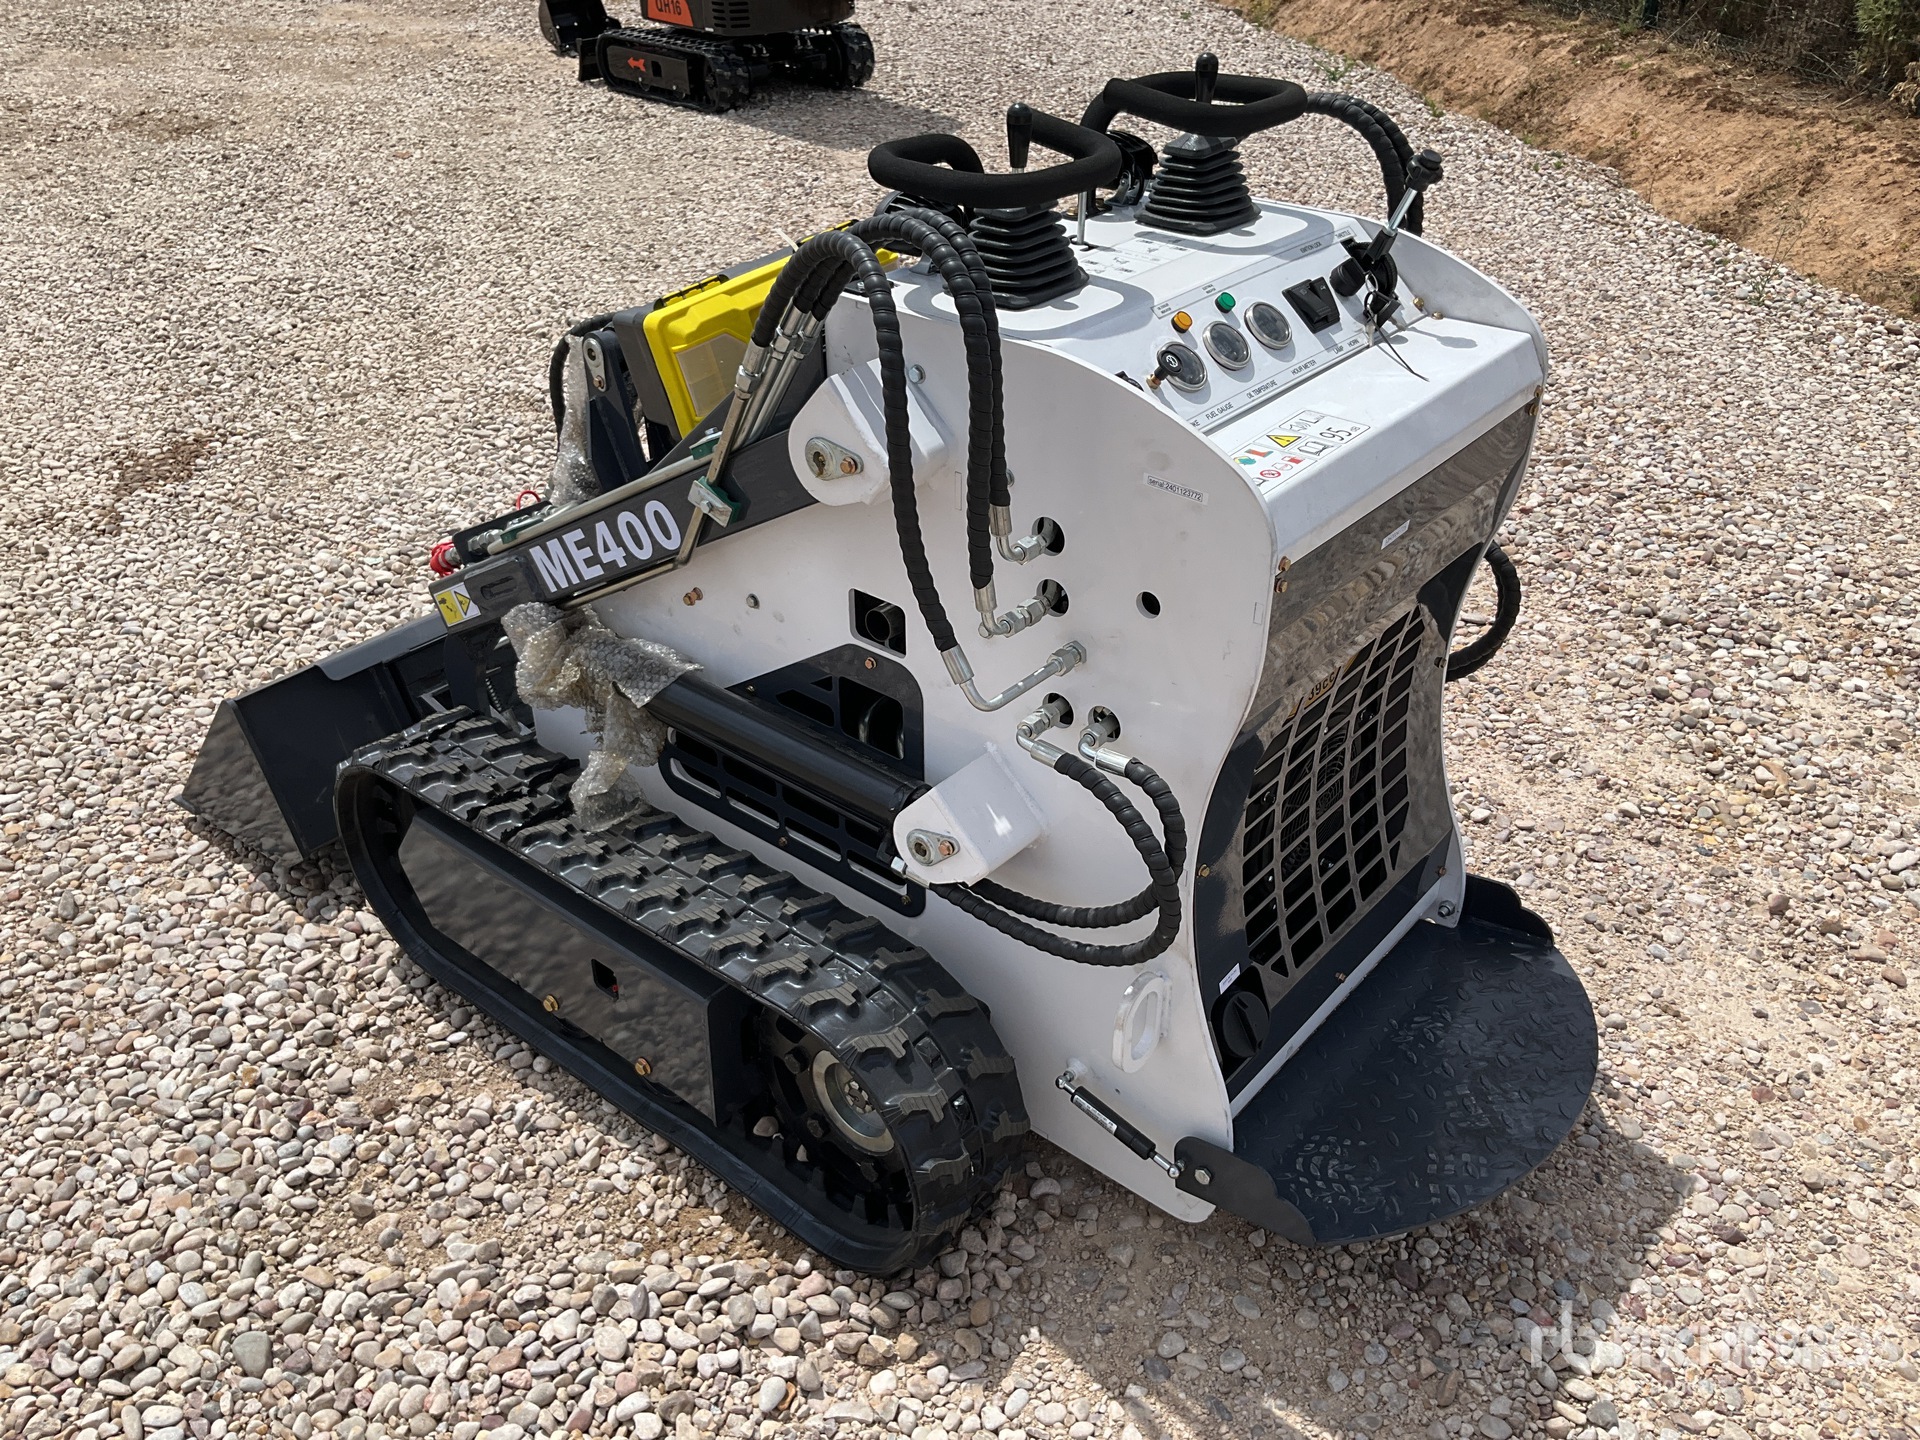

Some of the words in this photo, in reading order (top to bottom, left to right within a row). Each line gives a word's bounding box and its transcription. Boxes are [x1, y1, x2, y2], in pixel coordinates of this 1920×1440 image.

[1333, 345, 1344, 355] LAMP
[1347, 338, 1360, 348] HORN
[1291, 365, 1303, 376] HOUR
[1302, 359, 1317, 371] METER
[1253, 379, 1278, 397] TEMPERATURE
[1205, 410, 1219, 420] FUEL
[1217, 402, 1234, 414] GAUGE
[1319, 426, 1352, 441] 95
[529, 500, 682, 593] ME400
